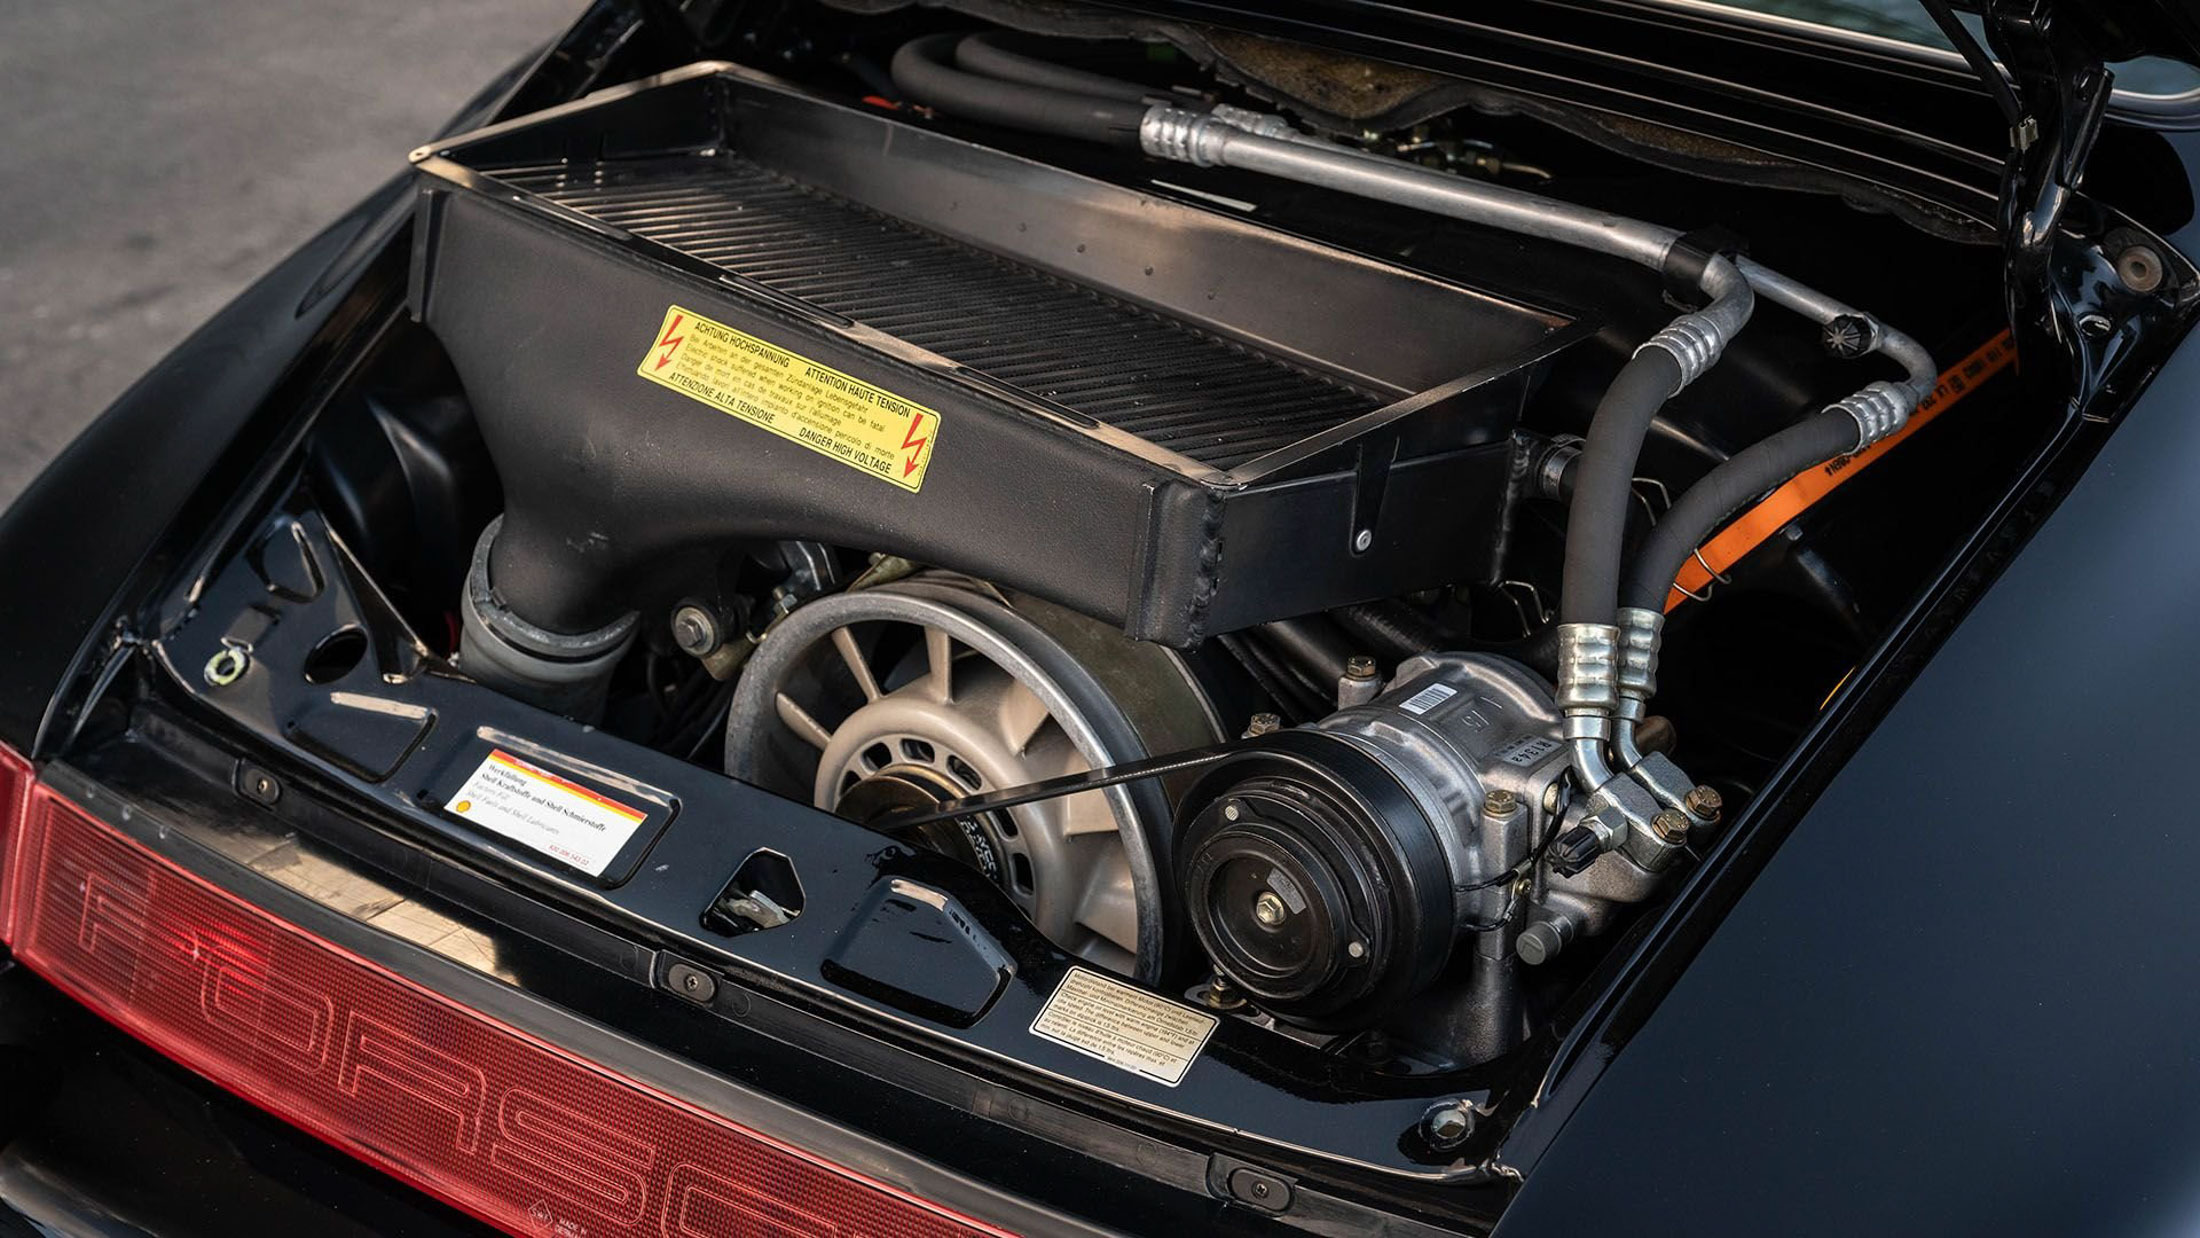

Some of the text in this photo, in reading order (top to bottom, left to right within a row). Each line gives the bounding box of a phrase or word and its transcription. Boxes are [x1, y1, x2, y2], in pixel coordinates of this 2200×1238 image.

[694, 322, 789, 366] ACHTUNG HOCHSPANNUNG
[669, 372, 774, 423] ATTENZIONE ALTA TENSIONE
[805, 367, 909, 417] ATTENTION HAUTE TENSION
[799, 427, 891, 473] DANGER HIGH VOLTAGE
[1511, 740, 1552, 763] R134a
[79, 872, 965, 1238] PORSC
